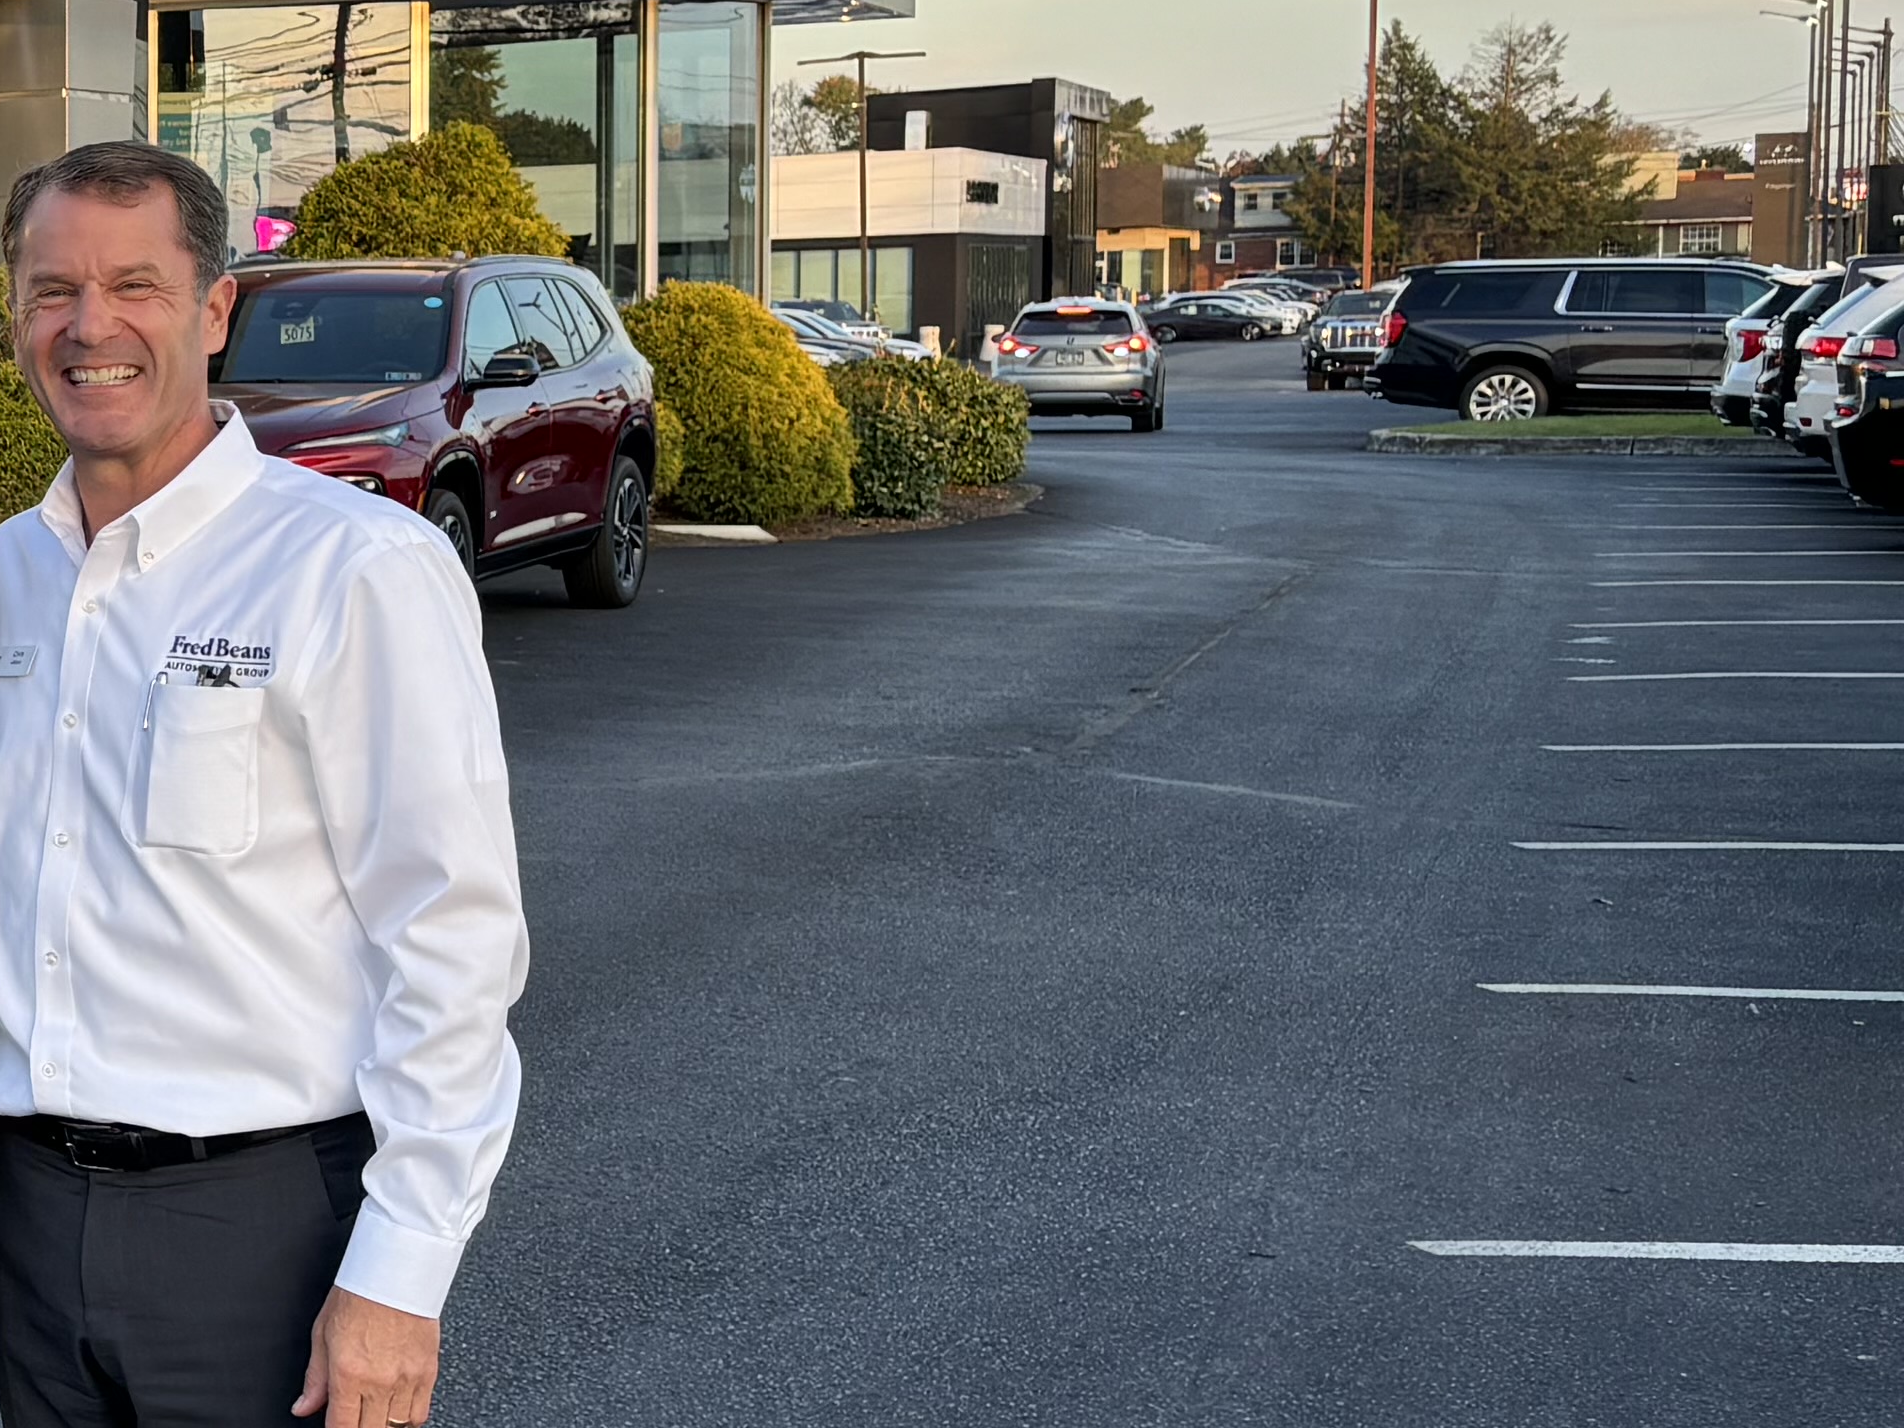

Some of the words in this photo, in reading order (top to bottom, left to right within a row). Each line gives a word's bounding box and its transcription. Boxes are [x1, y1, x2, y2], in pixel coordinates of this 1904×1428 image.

[284, 326, 312, 341] 5075
[169, 635, 214, 655] Fred
[215, 638, 271, 660] Beans
